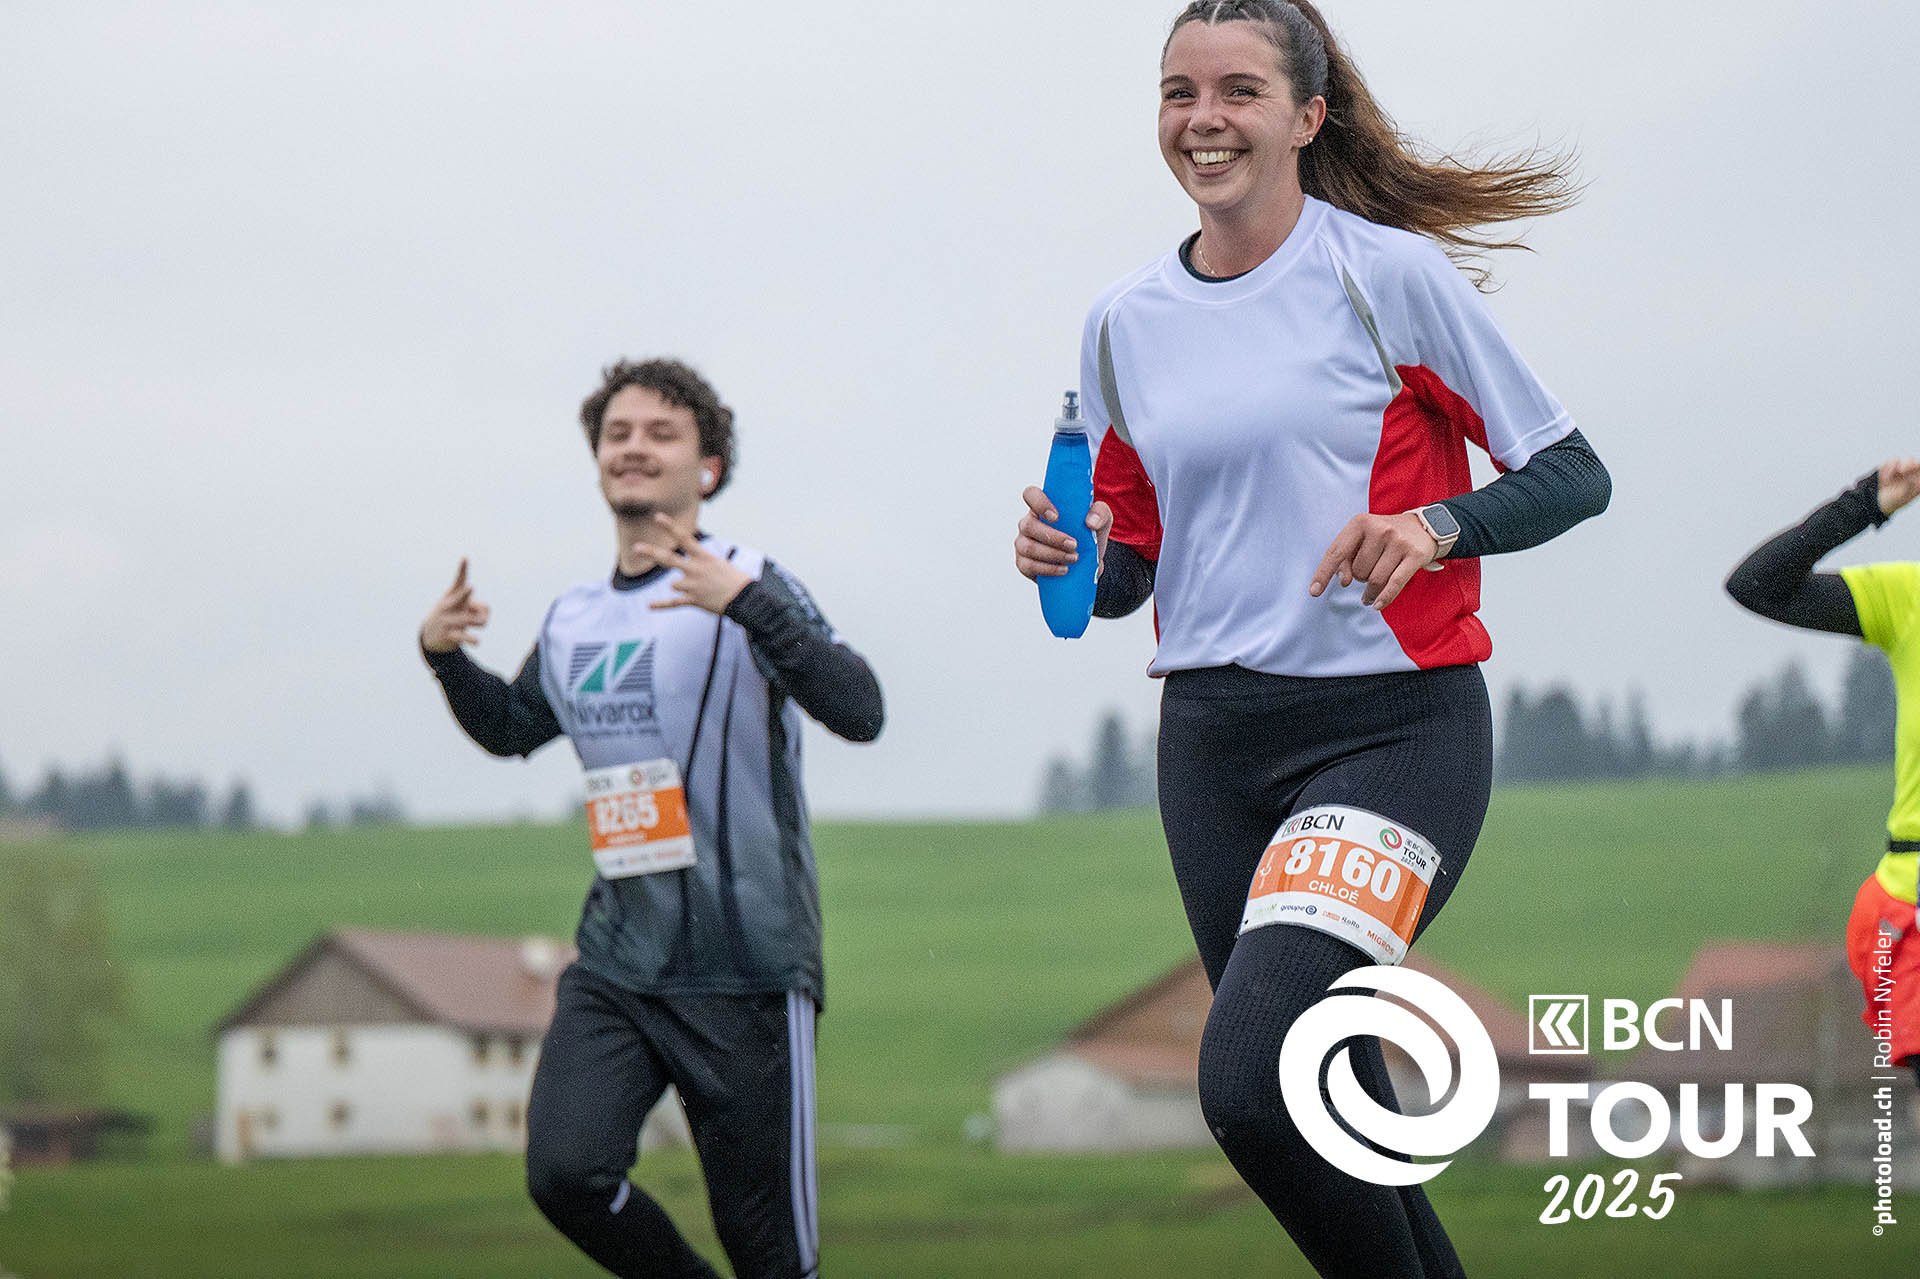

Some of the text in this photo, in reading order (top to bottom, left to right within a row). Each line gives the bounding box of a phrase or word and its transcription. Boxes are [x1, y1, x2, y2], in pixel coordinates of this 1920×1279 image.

[1301, 814, 1345, 831] BCN
[1284, 839, 1401, 902] 8160
[1403, 847, 1427, 870] TOUR
[1309, 880, 1360, 905] CHLOÉ
[1366, 929, 1396, 956] MIGROS
